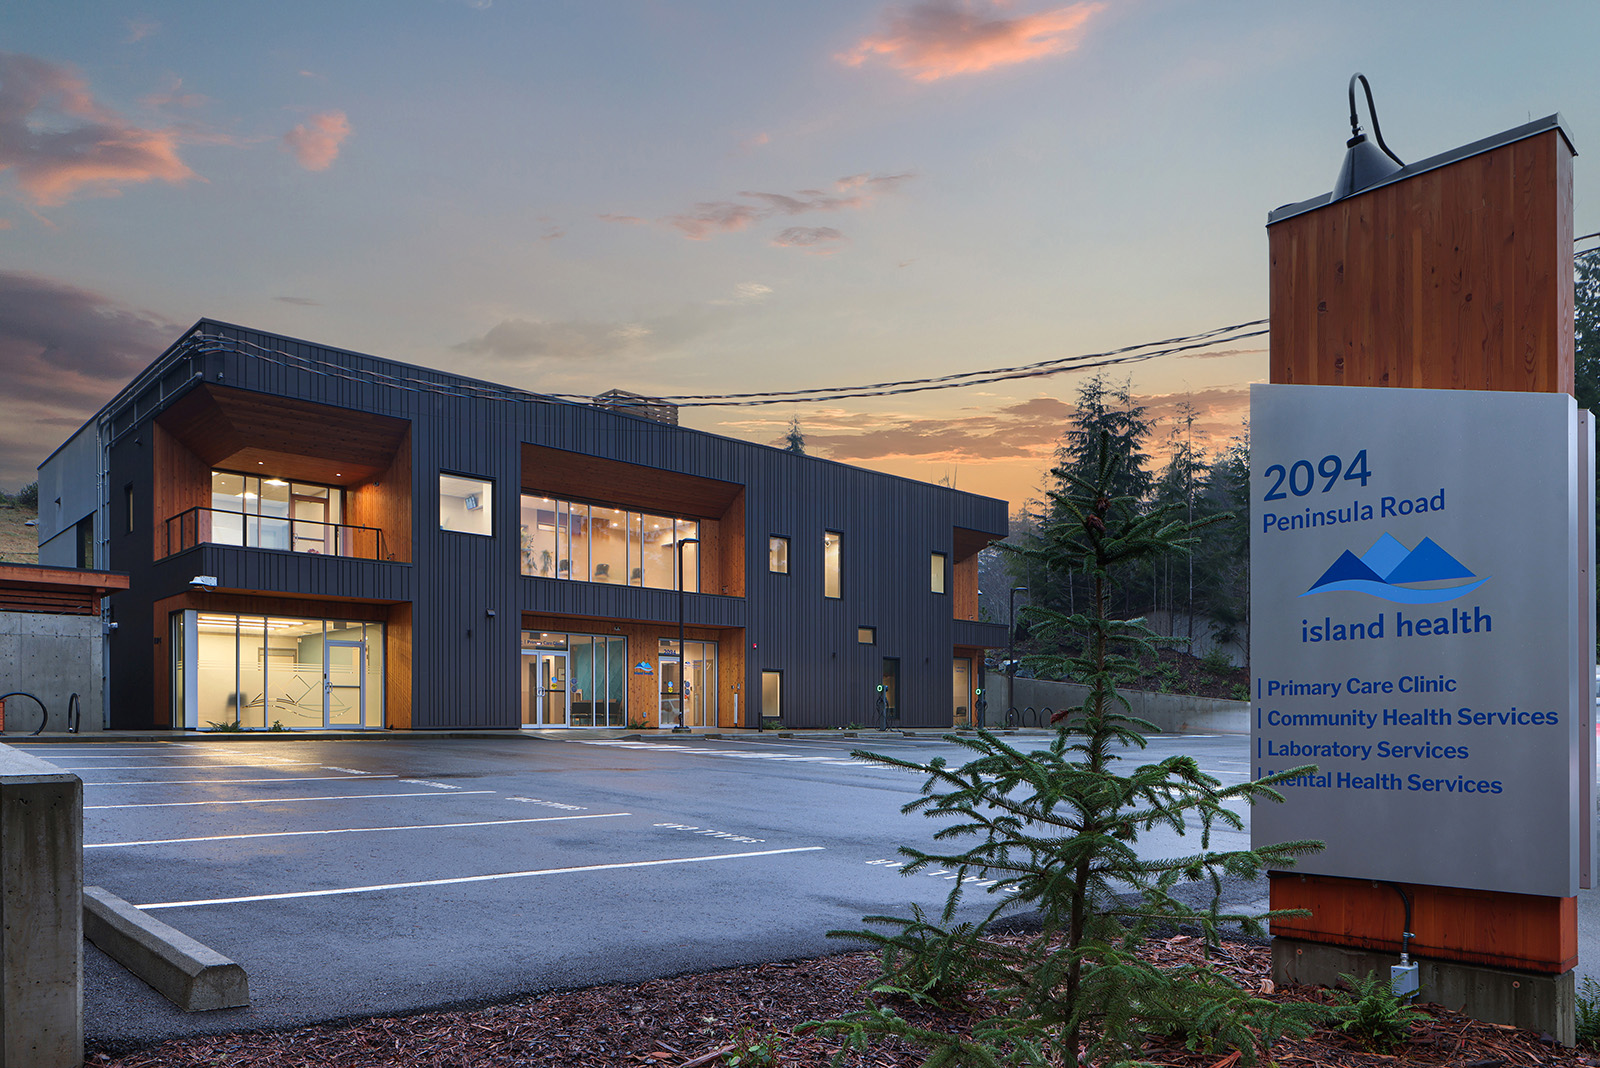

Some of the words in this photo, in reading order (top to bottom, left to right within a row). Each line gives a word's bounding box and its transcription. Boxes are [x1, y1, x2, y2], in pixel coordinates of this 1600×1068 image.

[1263, 449, 1372, 501] 2094
[1263, 500, 1374, 533] Peninsula
[1380, 488, 1445, 518] Road
[1301, 613, 1385, 643] island
[1396, 606, 1492, 638] health
[1267, 680, 1342, 698] Primary
[1346, 678, 1394, 695] Care
[1398, 675, 1457, 693] Clinic
[1267, 709, 1378, 729] Community
[1383, 708, 1452, 726] Health
[1457, 707, 1559, 726] Services
[1268, 740, 1373, 760] Laboratory
[1377, 741, 1469, 759] Services
[1336, 772, 1403, 791] Health
[1407, 774, 1503, 794] Services
